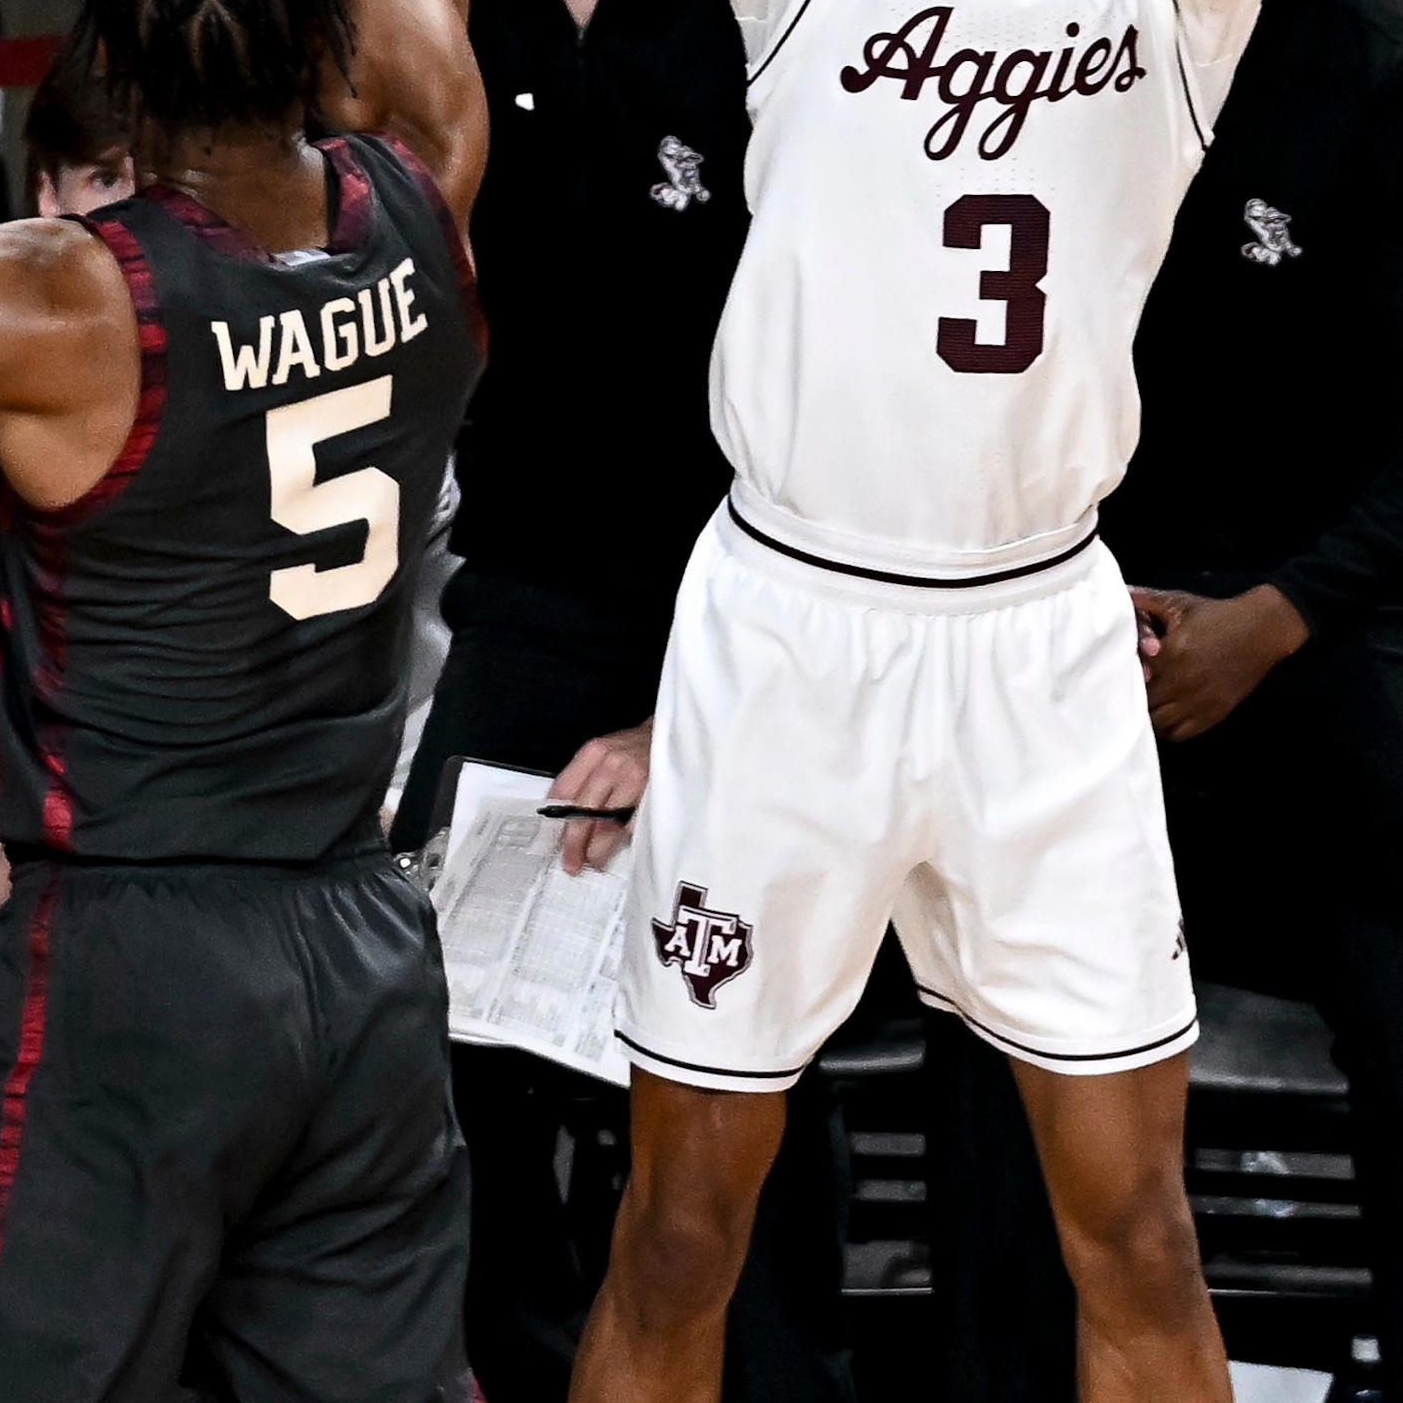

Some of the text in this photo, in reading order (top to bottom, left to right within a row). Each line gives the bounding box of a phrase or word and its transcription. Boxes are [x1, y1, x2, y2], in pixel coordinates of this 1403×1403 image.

[840, 6, 1147, 161] Aggies
[211, 257, 428, 391] WAGUE
[936, 194, 1051, 374] 3
[266, 374, 400, 621] 5
